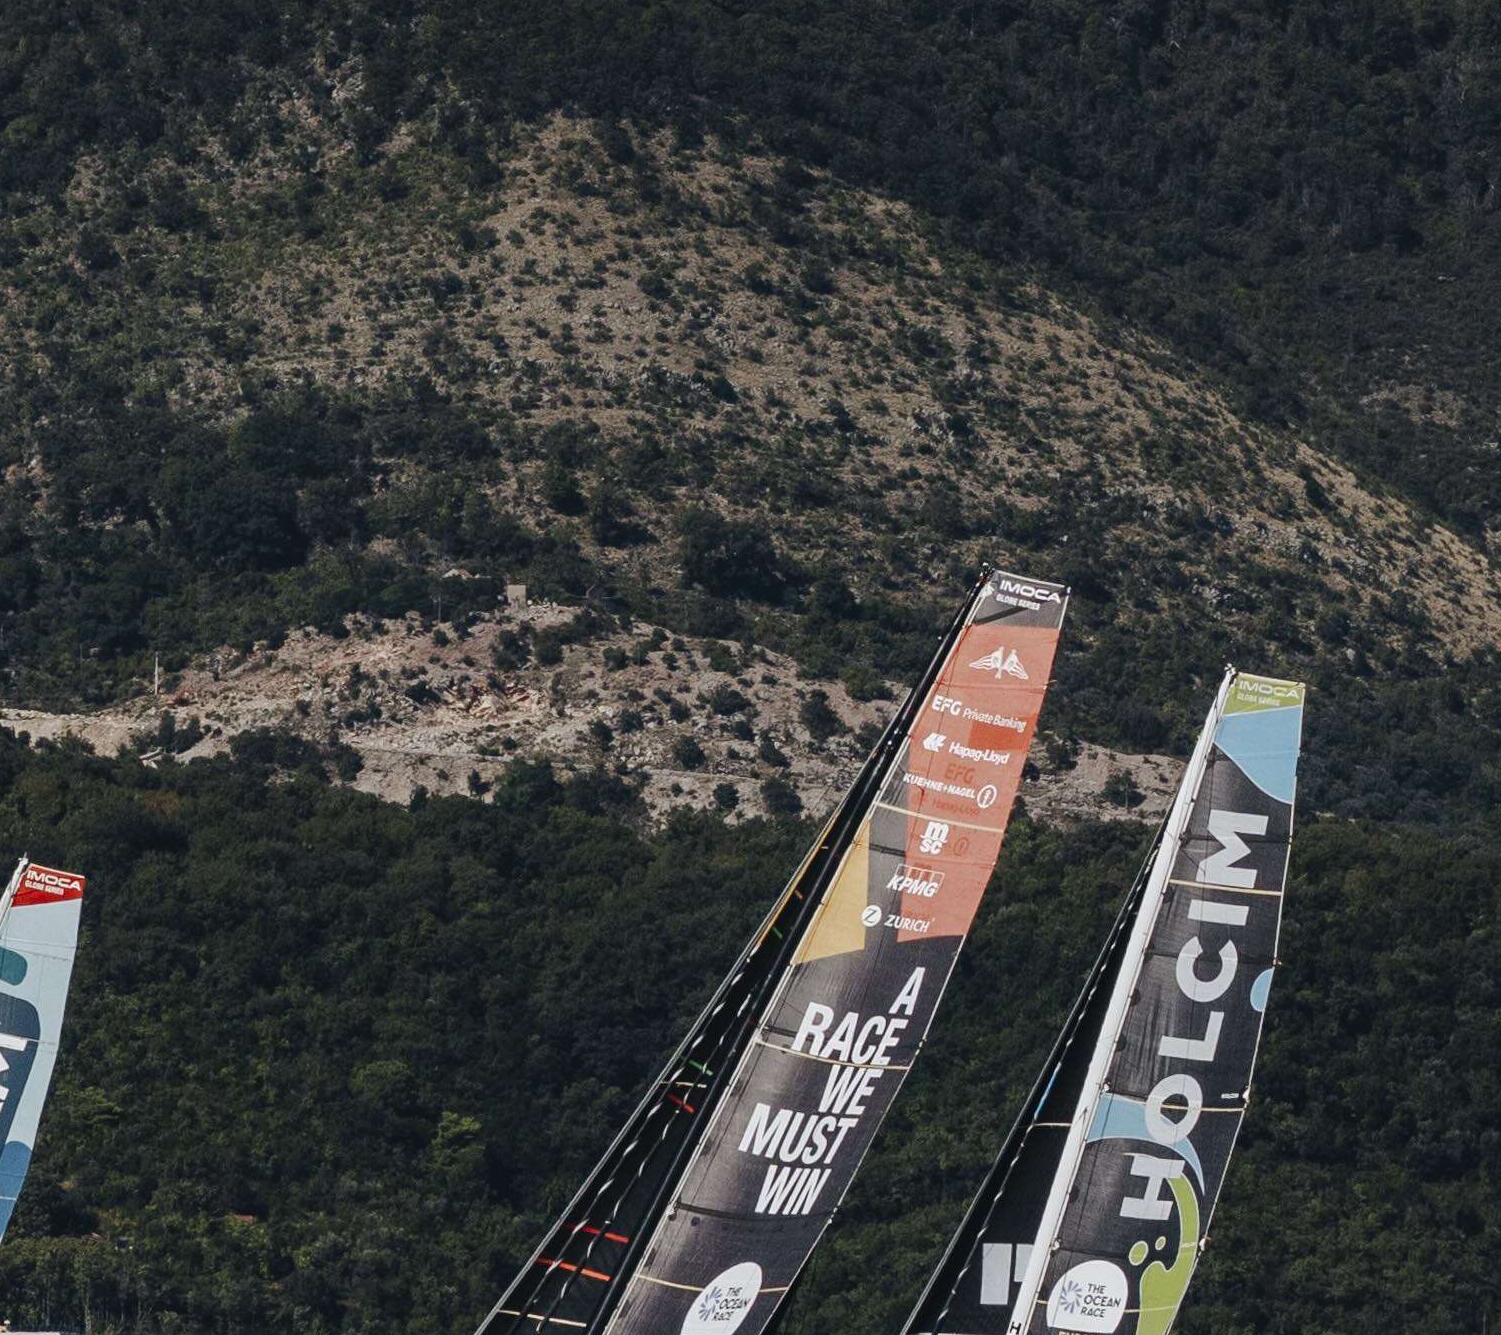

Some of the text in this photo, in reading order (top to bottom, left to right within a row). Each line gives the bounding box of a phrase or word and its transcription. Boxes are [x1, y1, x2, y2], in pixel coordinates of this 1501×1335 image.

[1000, 579, 1061, 604] IMOCA
[1239, 680, 1299, 698] IMOCA
[932, 694, 1027, 733] EFG Private Banking
[948, 741, 1011, 765] Hapag-Lloyd
[903, 772, 976, 799] KUEHNE+NAGEL
[26, 870, 81, 891] IMOCA
[886, 874, 939, 898] KPMG
[884, 914, 931, 933] ZURICH
[889, 967, 925, 1015] A
[1119, 809, 1269, 1221] HOLCIM
[791, 1002, 908, 1066] RACE
[818, 1065, 883, 1115] WE
[738, 1103, 859, 1164] MUST
[755, 1165, 832, 1215] WIN
[1083, 1294, 1121, 1308] OCEAN
[1087, 1283, 1106, 1294] THE
[1080, 1306, 1106, 1318] RACE
